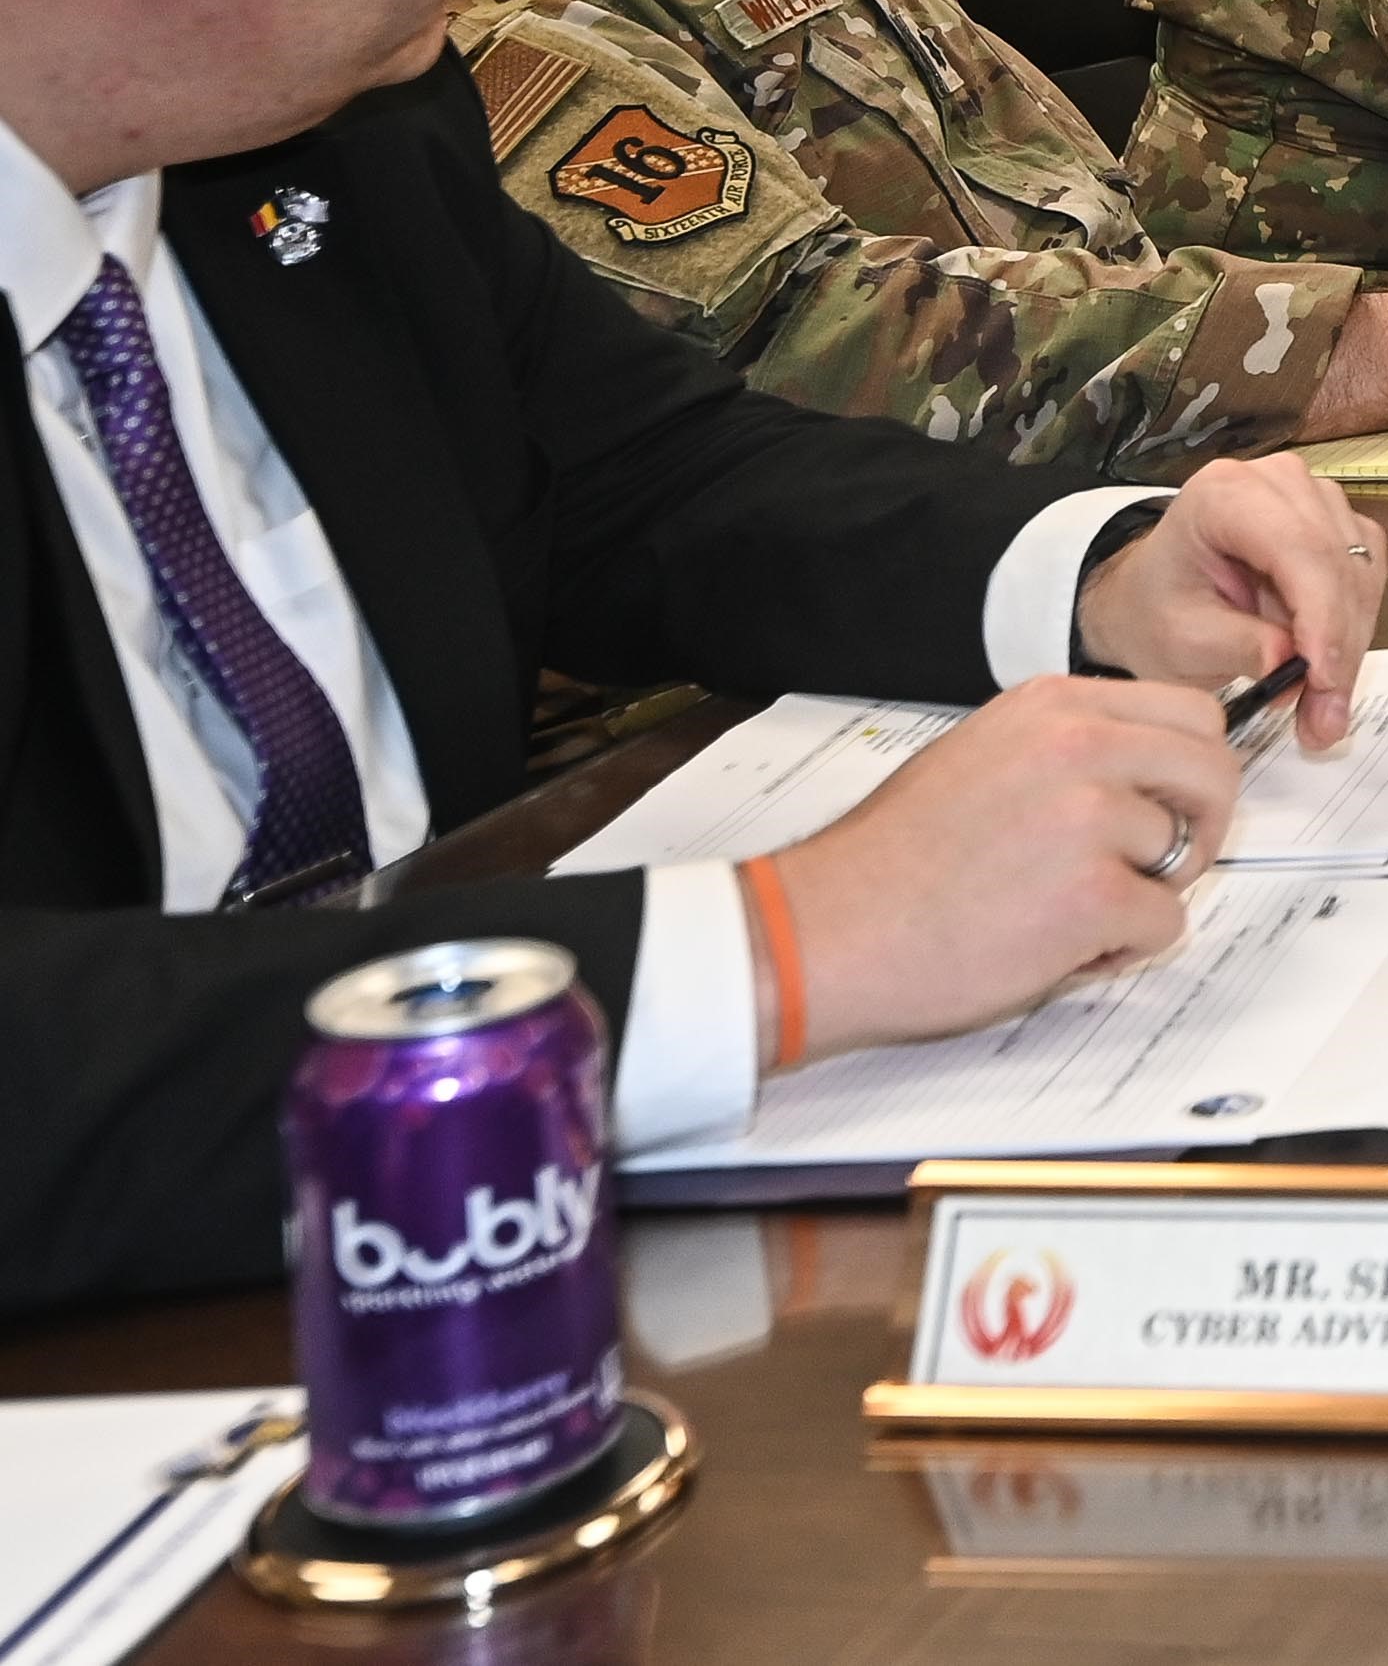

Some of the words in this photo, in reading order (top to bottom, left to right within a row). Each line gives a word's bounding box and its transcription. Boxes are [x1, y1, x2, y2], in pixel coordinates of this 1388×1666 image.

[584, 136, 686, 204] 16
[730, 148, 749, 184] FORCE
[725, 185, 744, 205] AIR
[644, 205, 731, 240] SIXTEENTH
[332, 1164, 600, 1286] bubly
[1235, 1260, 1329, 1302] MR.
[1142, 1310, 1280, 1347] CYBER
